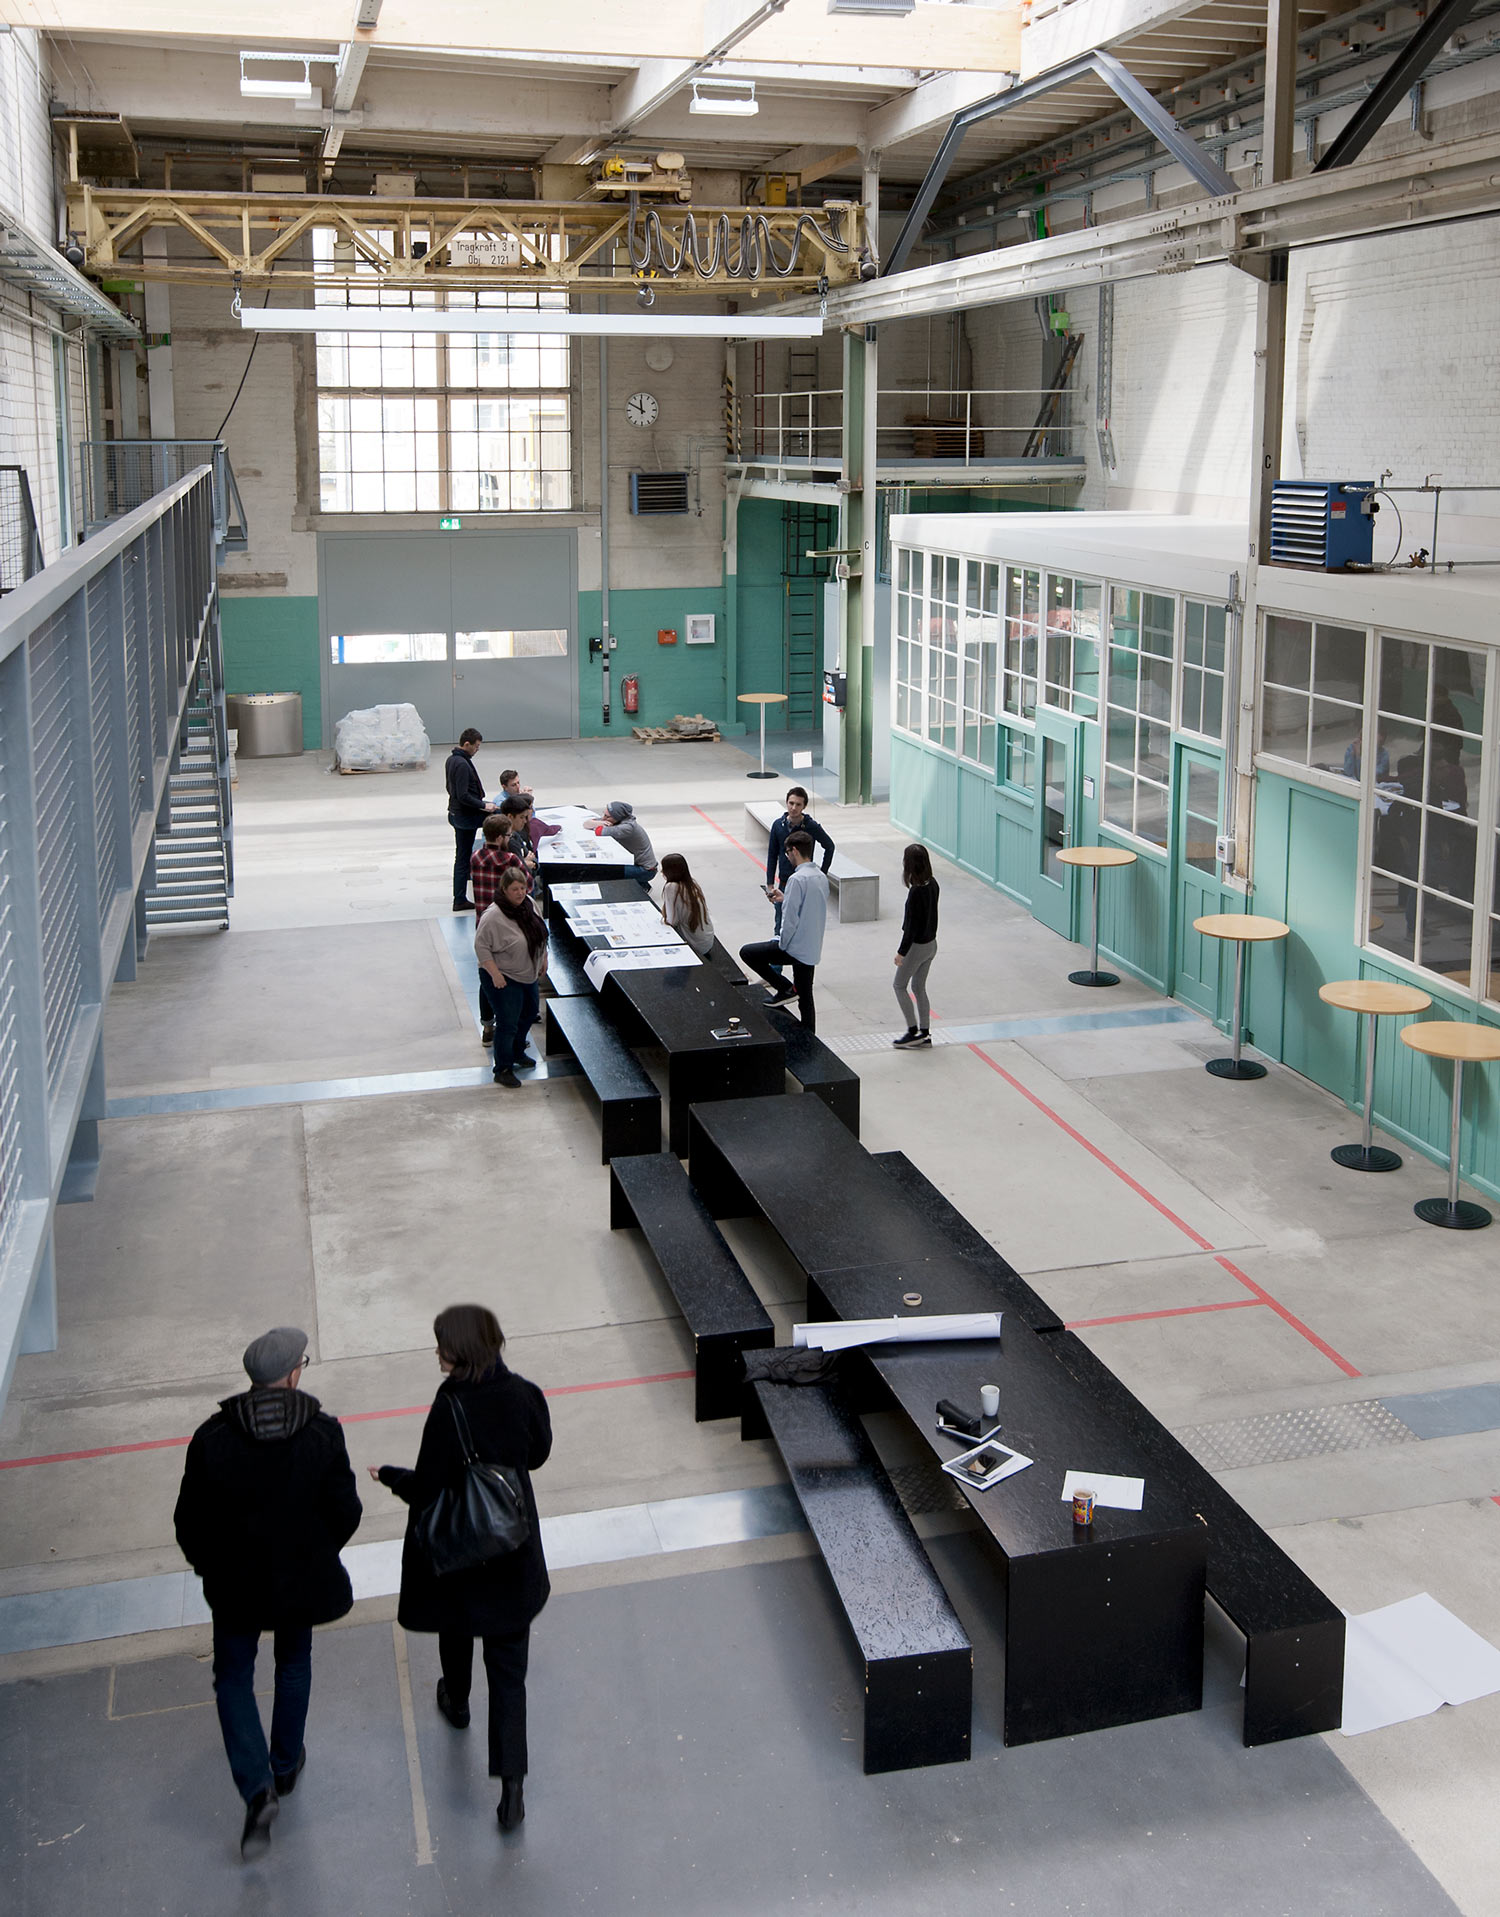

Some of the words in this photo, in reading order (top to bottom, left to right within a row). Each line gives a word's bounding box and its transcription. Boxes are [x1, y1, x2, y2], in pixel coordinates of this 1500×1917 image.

[456, 241, 496, 254] Tragkraft
[502, 241, 508, 252] 3
[511, 241, 516, 252] t
[491, 254, 509, 265] 2121
[1264, 454, 1272, 469] C
